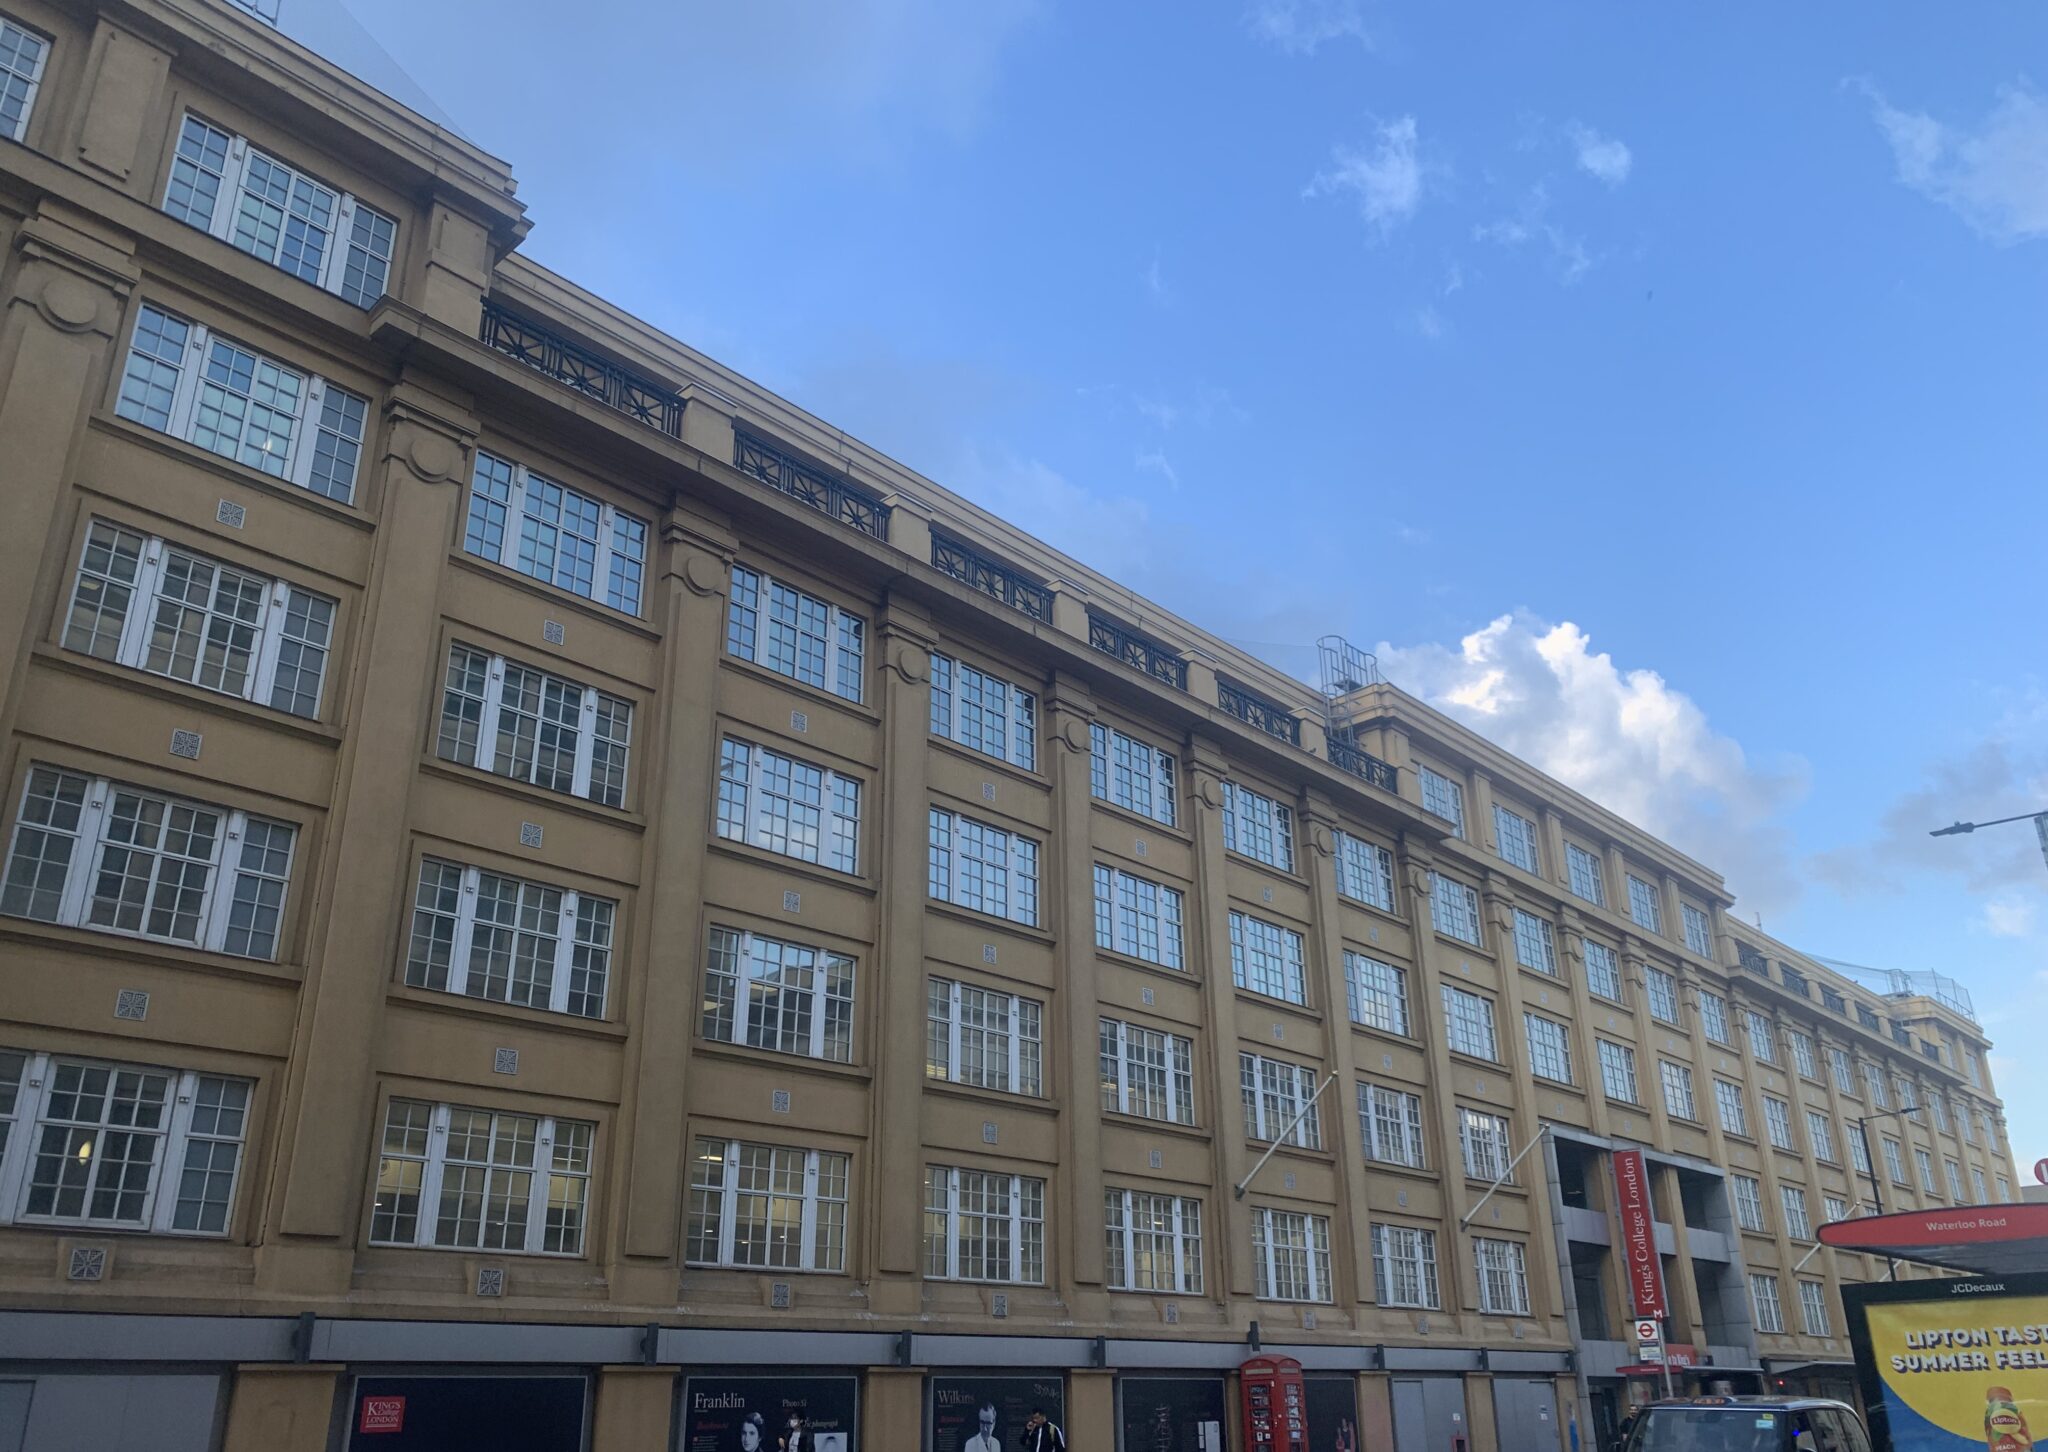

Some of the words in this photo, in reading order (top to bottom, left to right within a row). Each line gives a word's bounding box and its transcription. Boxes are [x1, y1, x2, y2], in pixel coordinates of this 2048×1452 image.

[1624, 1157, 1641, 1209] London
[1926, 1220, 1976, 1231] Waterloo
[1978, 1218, 2007, 1228] Road
[1632, 1211, 1649, 1262] College
[1636, 1264, 1656, 1305] King's
[1951, 1283, 2006, 1293] JCDecaux
[1653, 1309, 1663, 1319] M
[1904, 1328, 1990, 1349] LIPTON
[1993, 1324, 2048, 1346] TAST
[1890, 1351, 1991, 1373] SUMMER
[1994, 1349, 2048, 1370] FEEL
[694, 1392, 745, 1408] Franklin
[366, 1416, 399, 1424] LONDON
